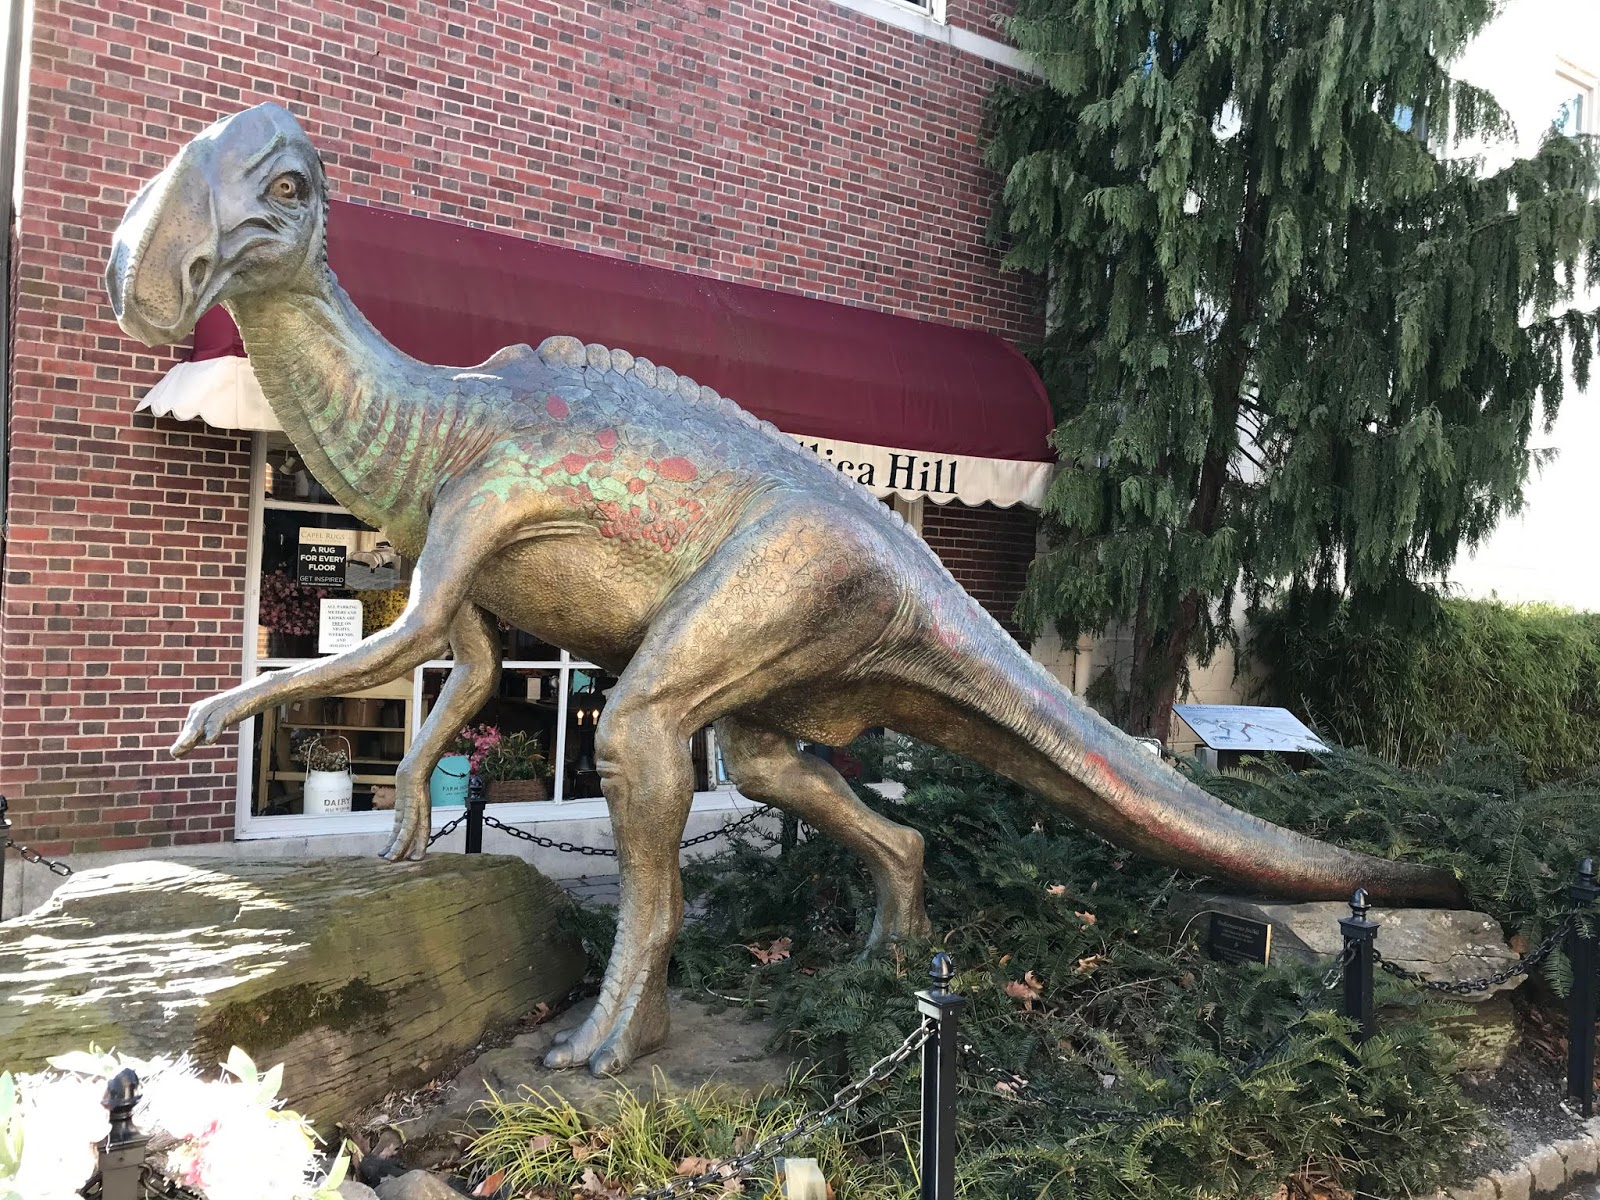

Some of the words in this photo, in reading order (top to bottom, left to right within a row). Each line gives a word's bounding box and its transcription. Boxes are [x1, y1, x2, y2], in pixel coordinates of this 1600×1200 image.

[886, 453, 958, 494] Hill
[325, 532, 345, 540] RUGS
[318, 546, 336, 554] RUG
[300, 554, 317, 562] FOR
[319, 555, 345, 563] EVERY
[308, 563, 336, 571] FLOOR
[324, 797, 350, 806] DAIRY
